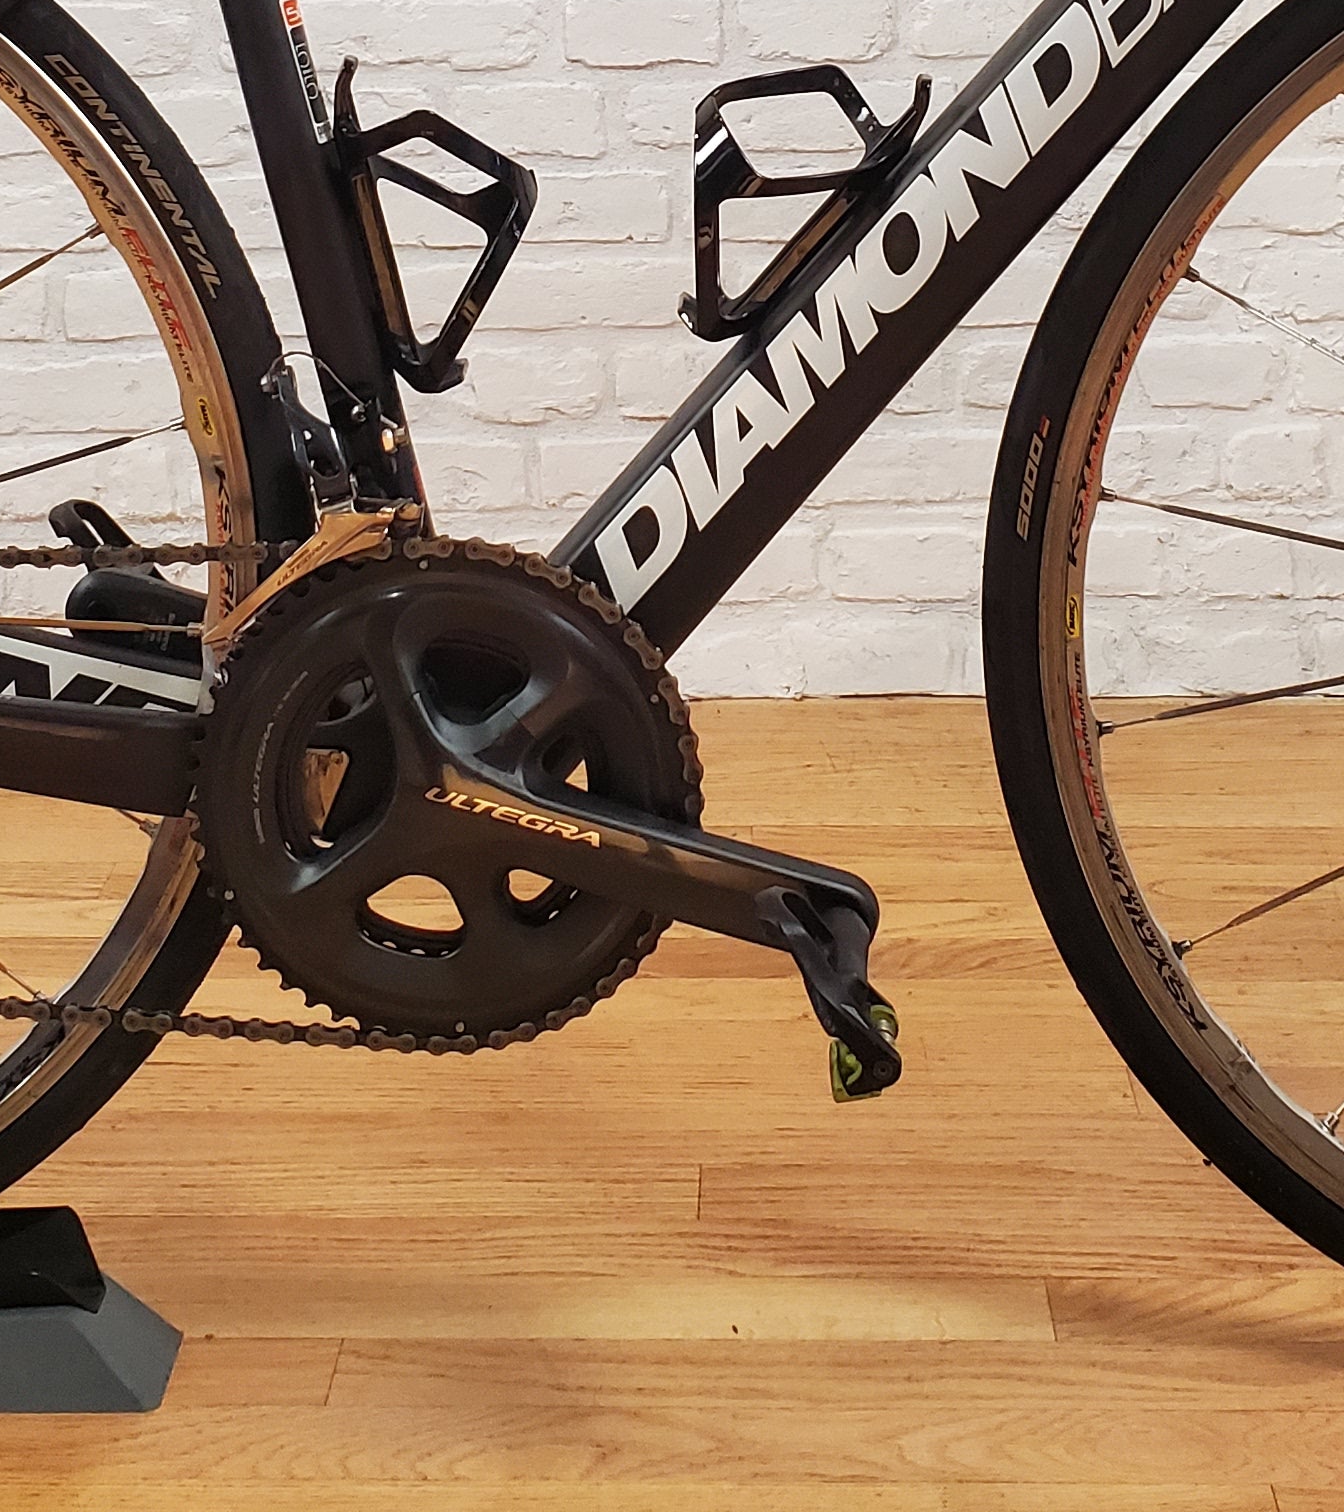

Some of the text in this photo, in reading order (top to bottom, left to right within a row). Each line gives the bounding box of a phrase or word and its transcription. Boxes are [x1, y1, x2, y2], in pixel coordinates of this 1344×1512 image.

[44, 51, 223, 300] CONTINENTAL
[121, 222, 194, 354] ELITE
[1017, 430, 1047, 541] 5000
[1073, 695, 1096, 769] KSYRIUM
[424, 786, 601, 849] ULTEGRA
[1095, 826, 1209, 1035] KSYRIUM
